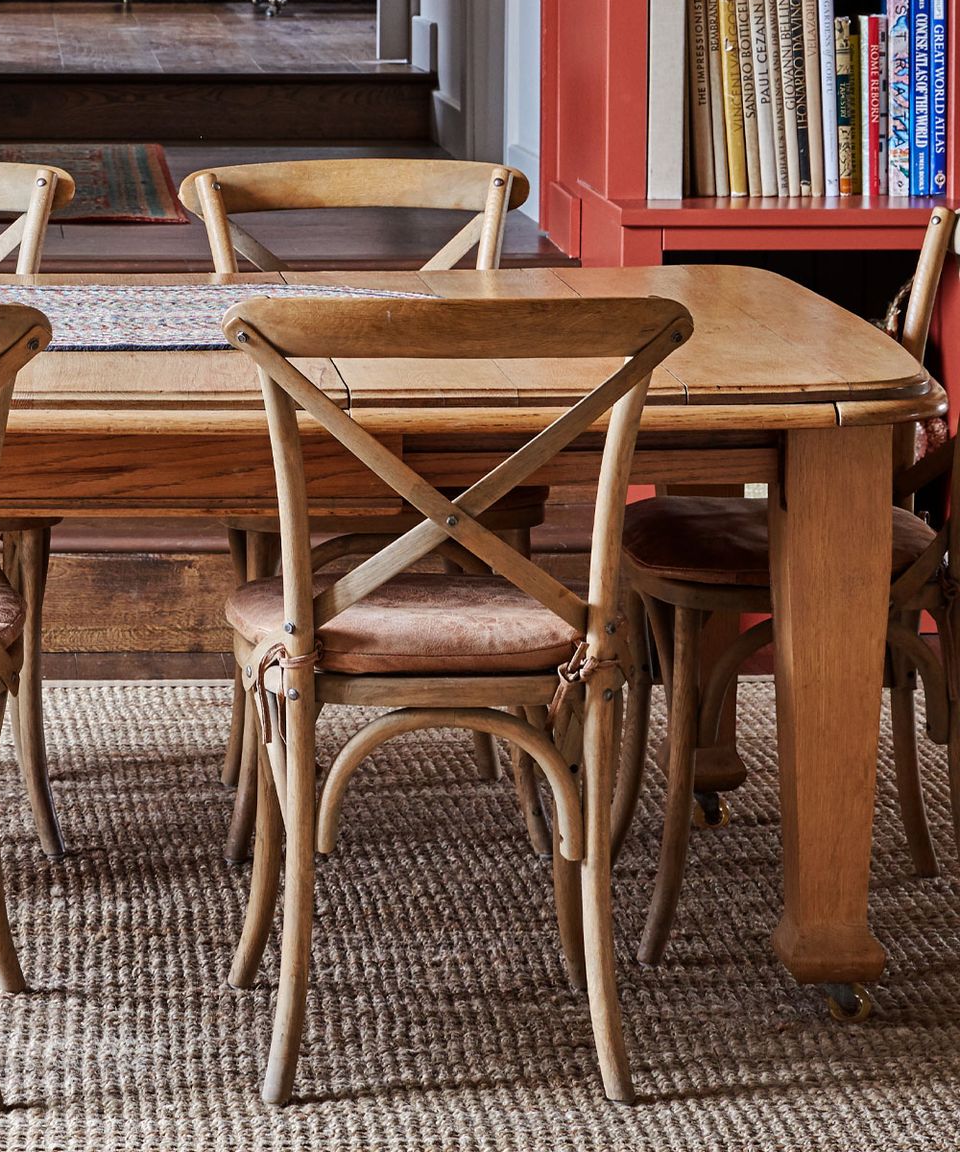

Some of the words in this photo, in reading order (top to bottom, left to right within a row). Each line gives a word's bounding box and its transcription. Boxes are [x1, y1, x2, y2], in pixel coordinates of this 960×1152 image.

[823, 0, 832, 47] GARDENS
[915, 13, 928, 50] CONCISE
[728, 38, 738, 69] VAN
[773, 51, 781, 73] AND
[794, 35, 805, 52] DA
[823, 50, 833, 59] of
[870, 44, 879, 77] ROME
[933, 24, 944, 65] GREAT
[783, 44, 796, 111] GIOVANNI
[825, 61, 833, 95] CORFU
[894, 5, 907, 148] STRATA
[915, 51, 928, 82] ATLAS
[698, 88, 707, 106] THE
[731, 72, 744, 133] VINCENT
[742, 63, 756, 119] SANDRO
[758, 69, 771, 105] PAUL
[775, 78, 785, 132] PAINTINGS
[795, 57, 807, 129] LEONARDO
[839, 82, 848, 119] TAPESTRY
[870, 79, 879, 123] REBORN
[915, 82, 928, 94] OF
[915, 95, 928, 111] THE
[934, 66, 945, 115] WORLD
[915, 111, 928, 148] WORLD
[934, 116, 946, 154] ATLAS
[779, 135, 789, 189] RAPHAEL'S
